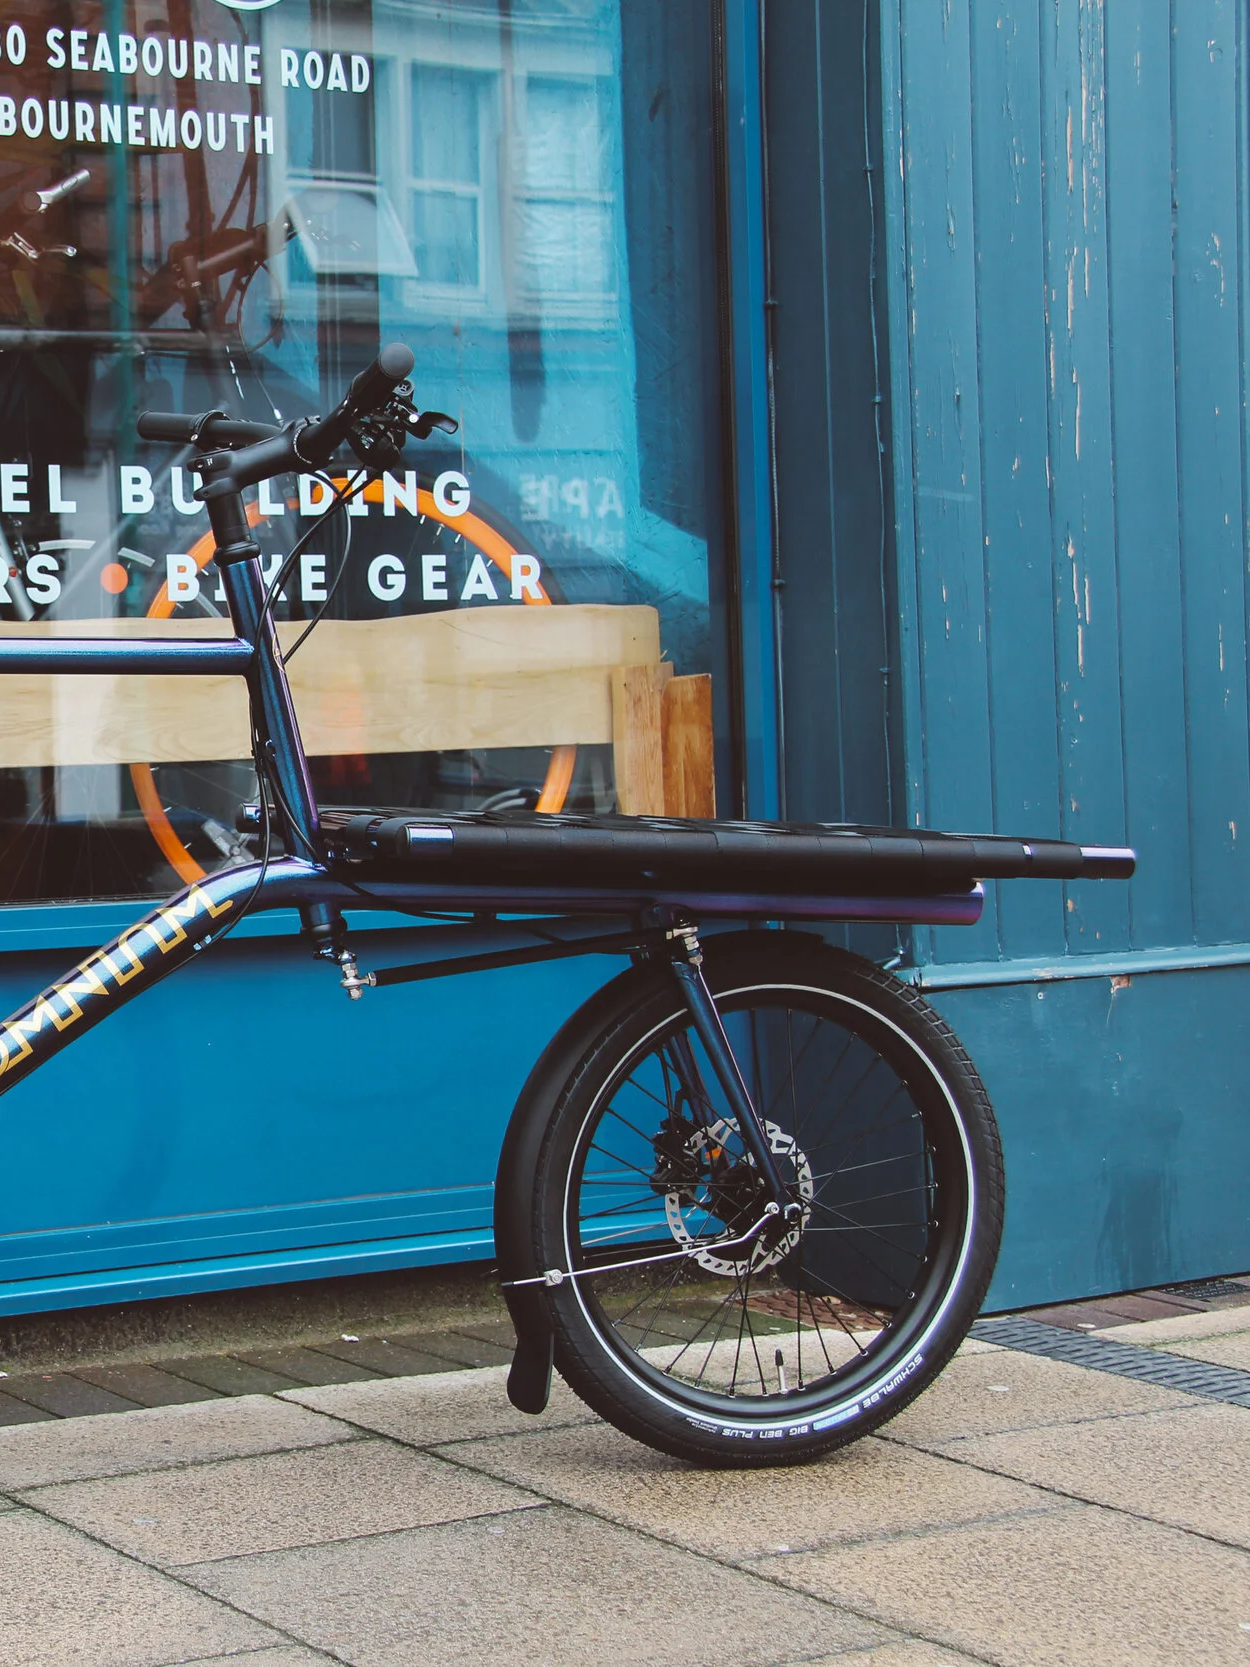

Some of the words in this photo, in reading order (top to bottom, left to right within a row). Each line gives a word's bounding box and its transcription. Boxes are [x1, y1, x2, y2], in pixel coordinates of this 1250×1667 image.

[47, 29, 261, 84] SEABOURNE
[281, 49, 370, 92] ROAD
[121, 466, 471, 517] BULDING
[368, 554, 543, 600] GEAR
[862, 1353, 923, 1409] SCHWALBE
[722, 1428, 753, 1439] PLUS
[789, 1425, 808, 1436] BIG
